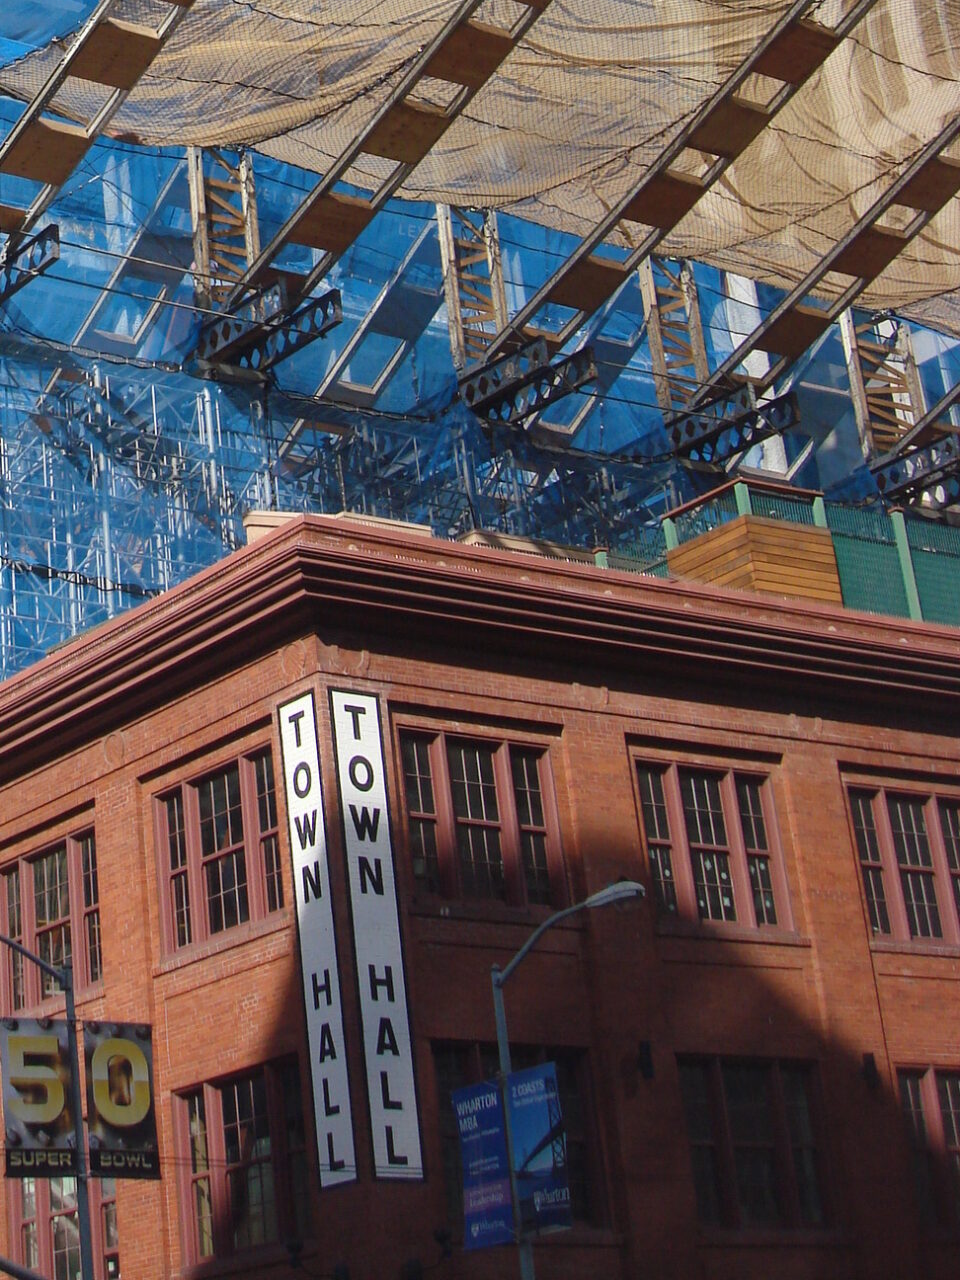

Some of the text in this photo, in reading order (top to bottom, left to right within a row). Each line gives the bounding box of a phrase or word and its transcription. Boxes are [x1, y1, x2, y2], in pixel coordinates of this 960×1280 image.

[288, 709, 346, 1173] TOWN HALL
[344, 704, 409, 1166] TOWN HALL
[456, 1091, 498, 1116] WHARTON
[459, 1115, 479, 1133] MBA
[10, 1151, 152, 1168] SUPER BOWL
